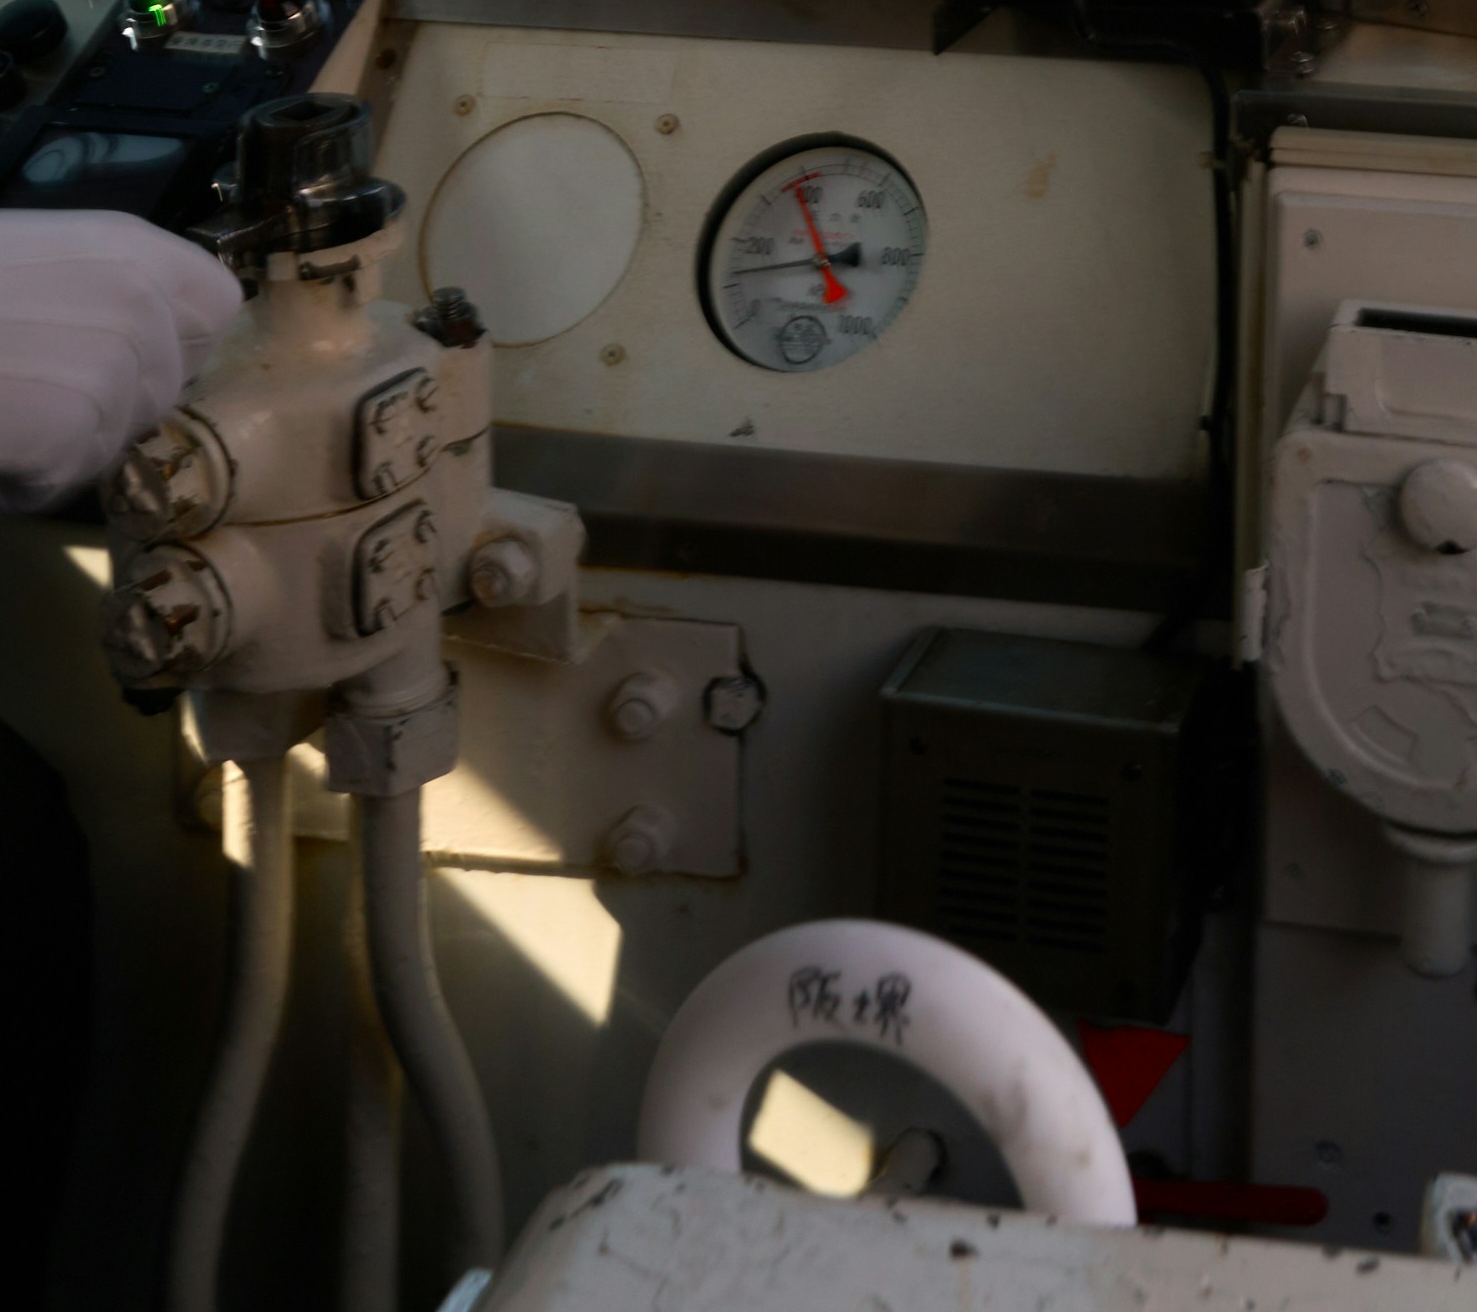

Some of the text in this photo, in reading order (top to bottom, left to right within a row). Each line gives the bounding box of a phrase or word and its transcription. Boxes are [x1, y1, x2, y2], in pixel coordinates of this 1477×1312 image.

[858, 190, 884, 209] 600
[748, 237, 774, 255] 200
[881, 247, 910, 266] 800
